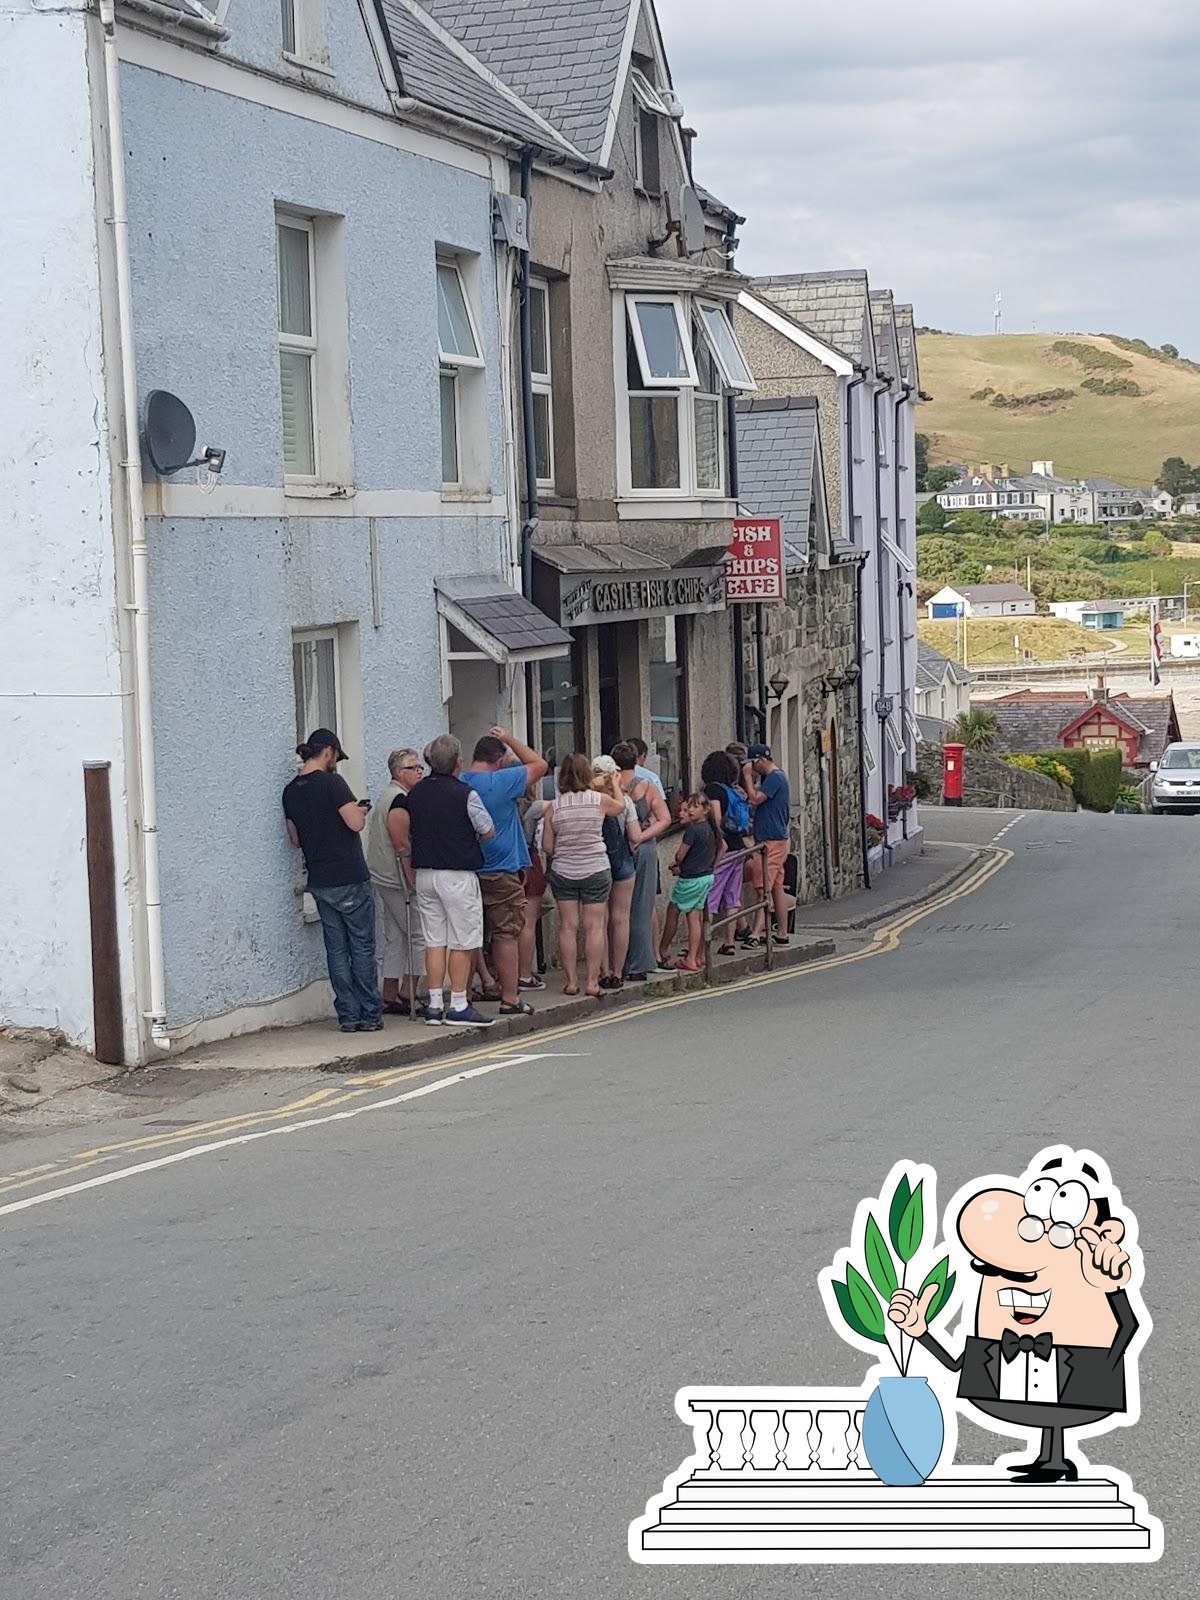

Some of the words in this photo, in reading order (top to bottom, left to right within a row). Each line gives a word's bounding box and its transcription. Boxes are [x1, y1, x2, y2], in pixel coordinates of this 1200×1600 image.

[743, 544, 754, 556] &
[594, 582, 638, 611] CASTLE
[640, 580, 664, 607] FISH
[667, 580, 675, 606] &
[677, 577, 705, 604] CHIPS
[727, 578, 775, 594] CAFE
